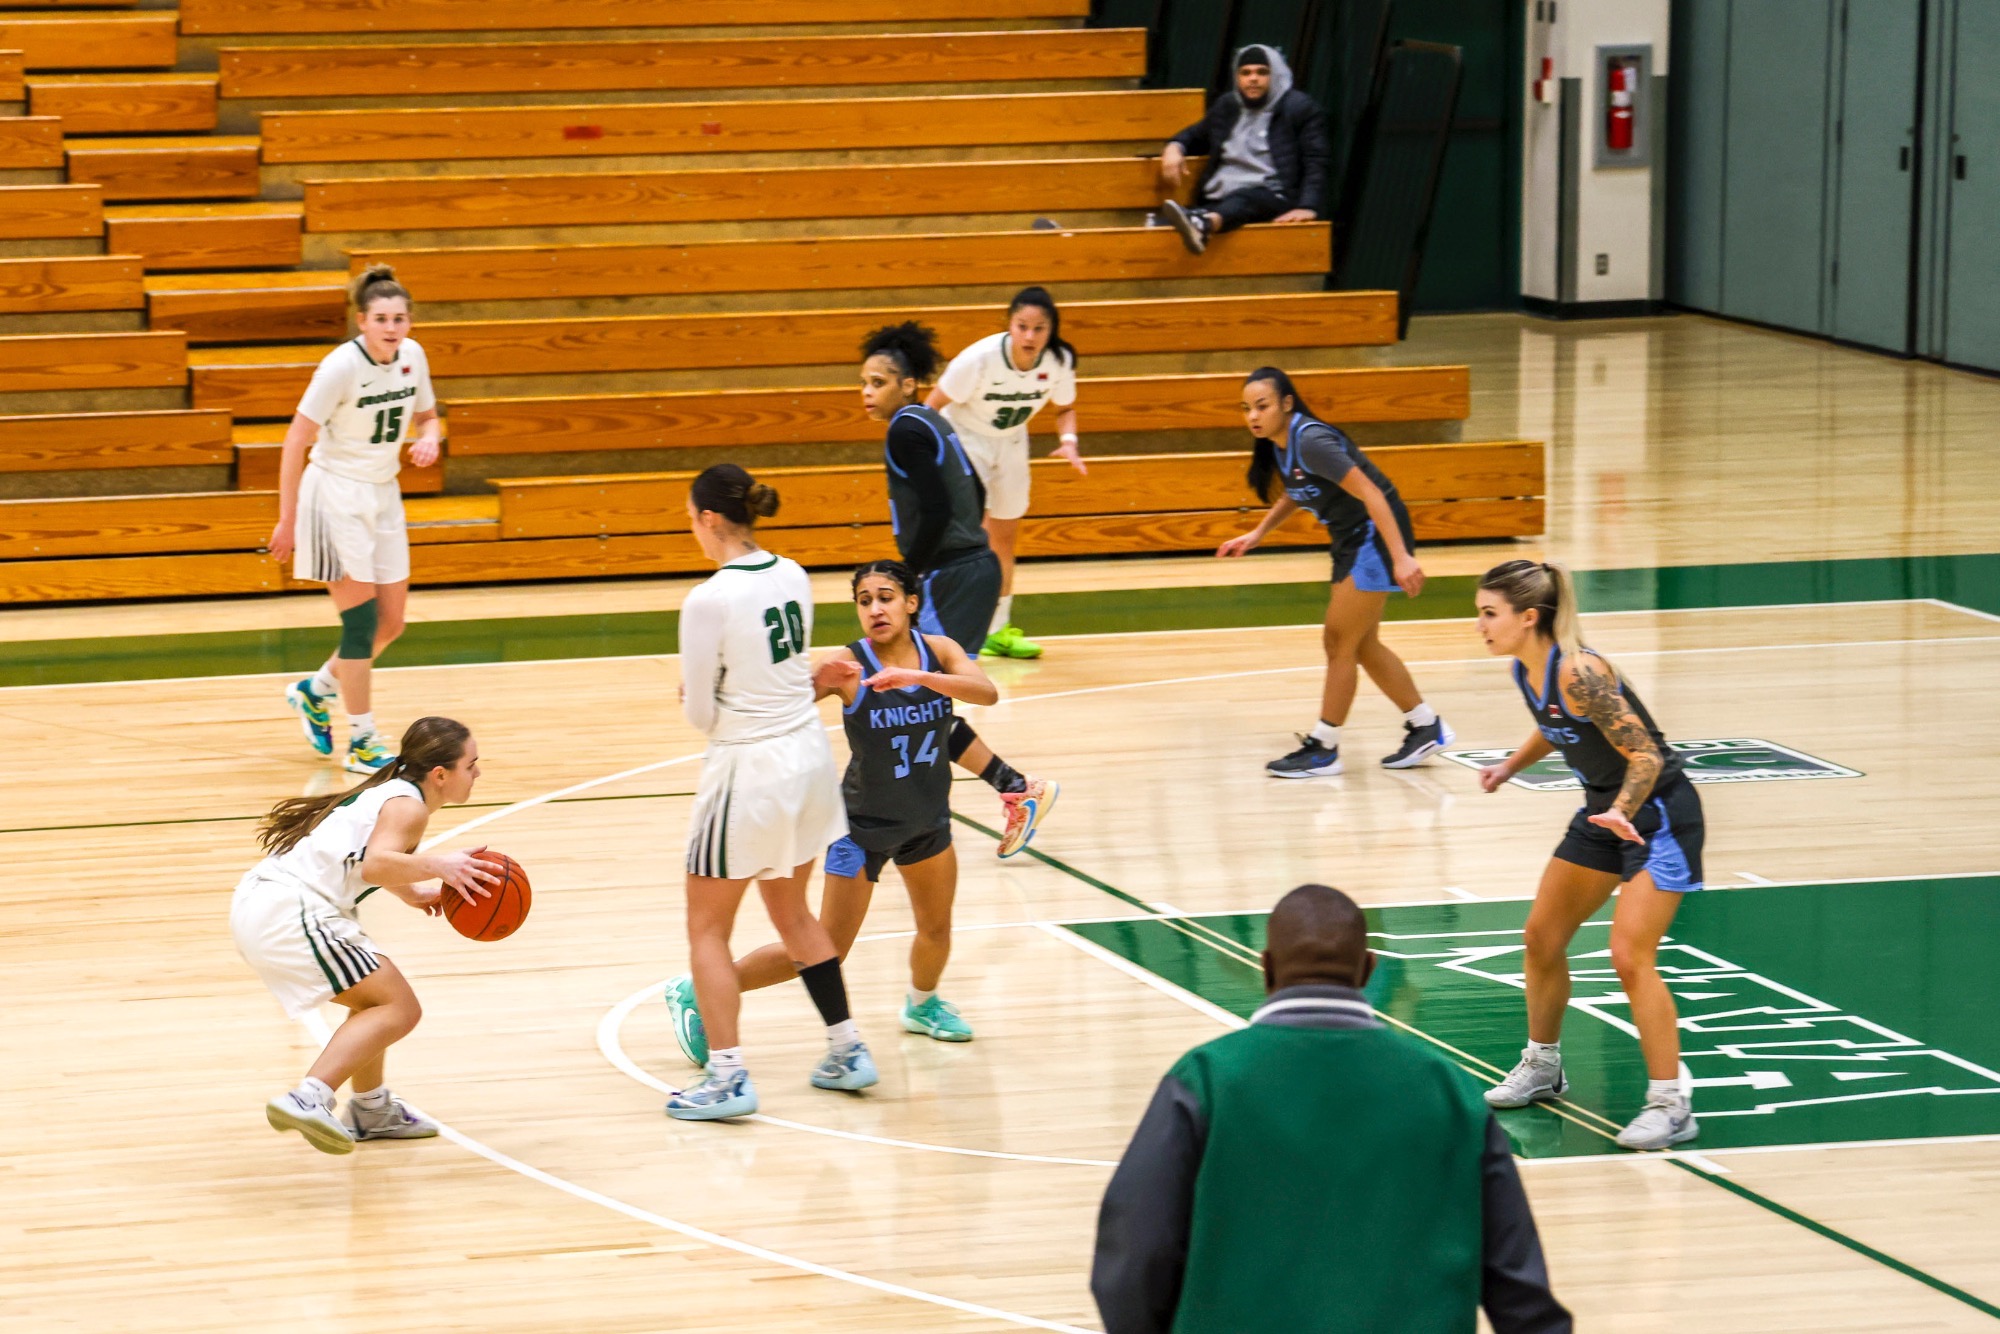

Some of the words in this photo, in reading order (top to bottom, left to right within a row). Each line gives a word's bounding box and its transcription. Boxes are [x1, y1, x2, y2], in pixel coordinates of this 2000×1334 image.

[370, 406, 404, 444] 15
[992, 406, 1033, 430] 30
[764, 600, 804, 664] 20
[891, 730, 939, 779] 34
